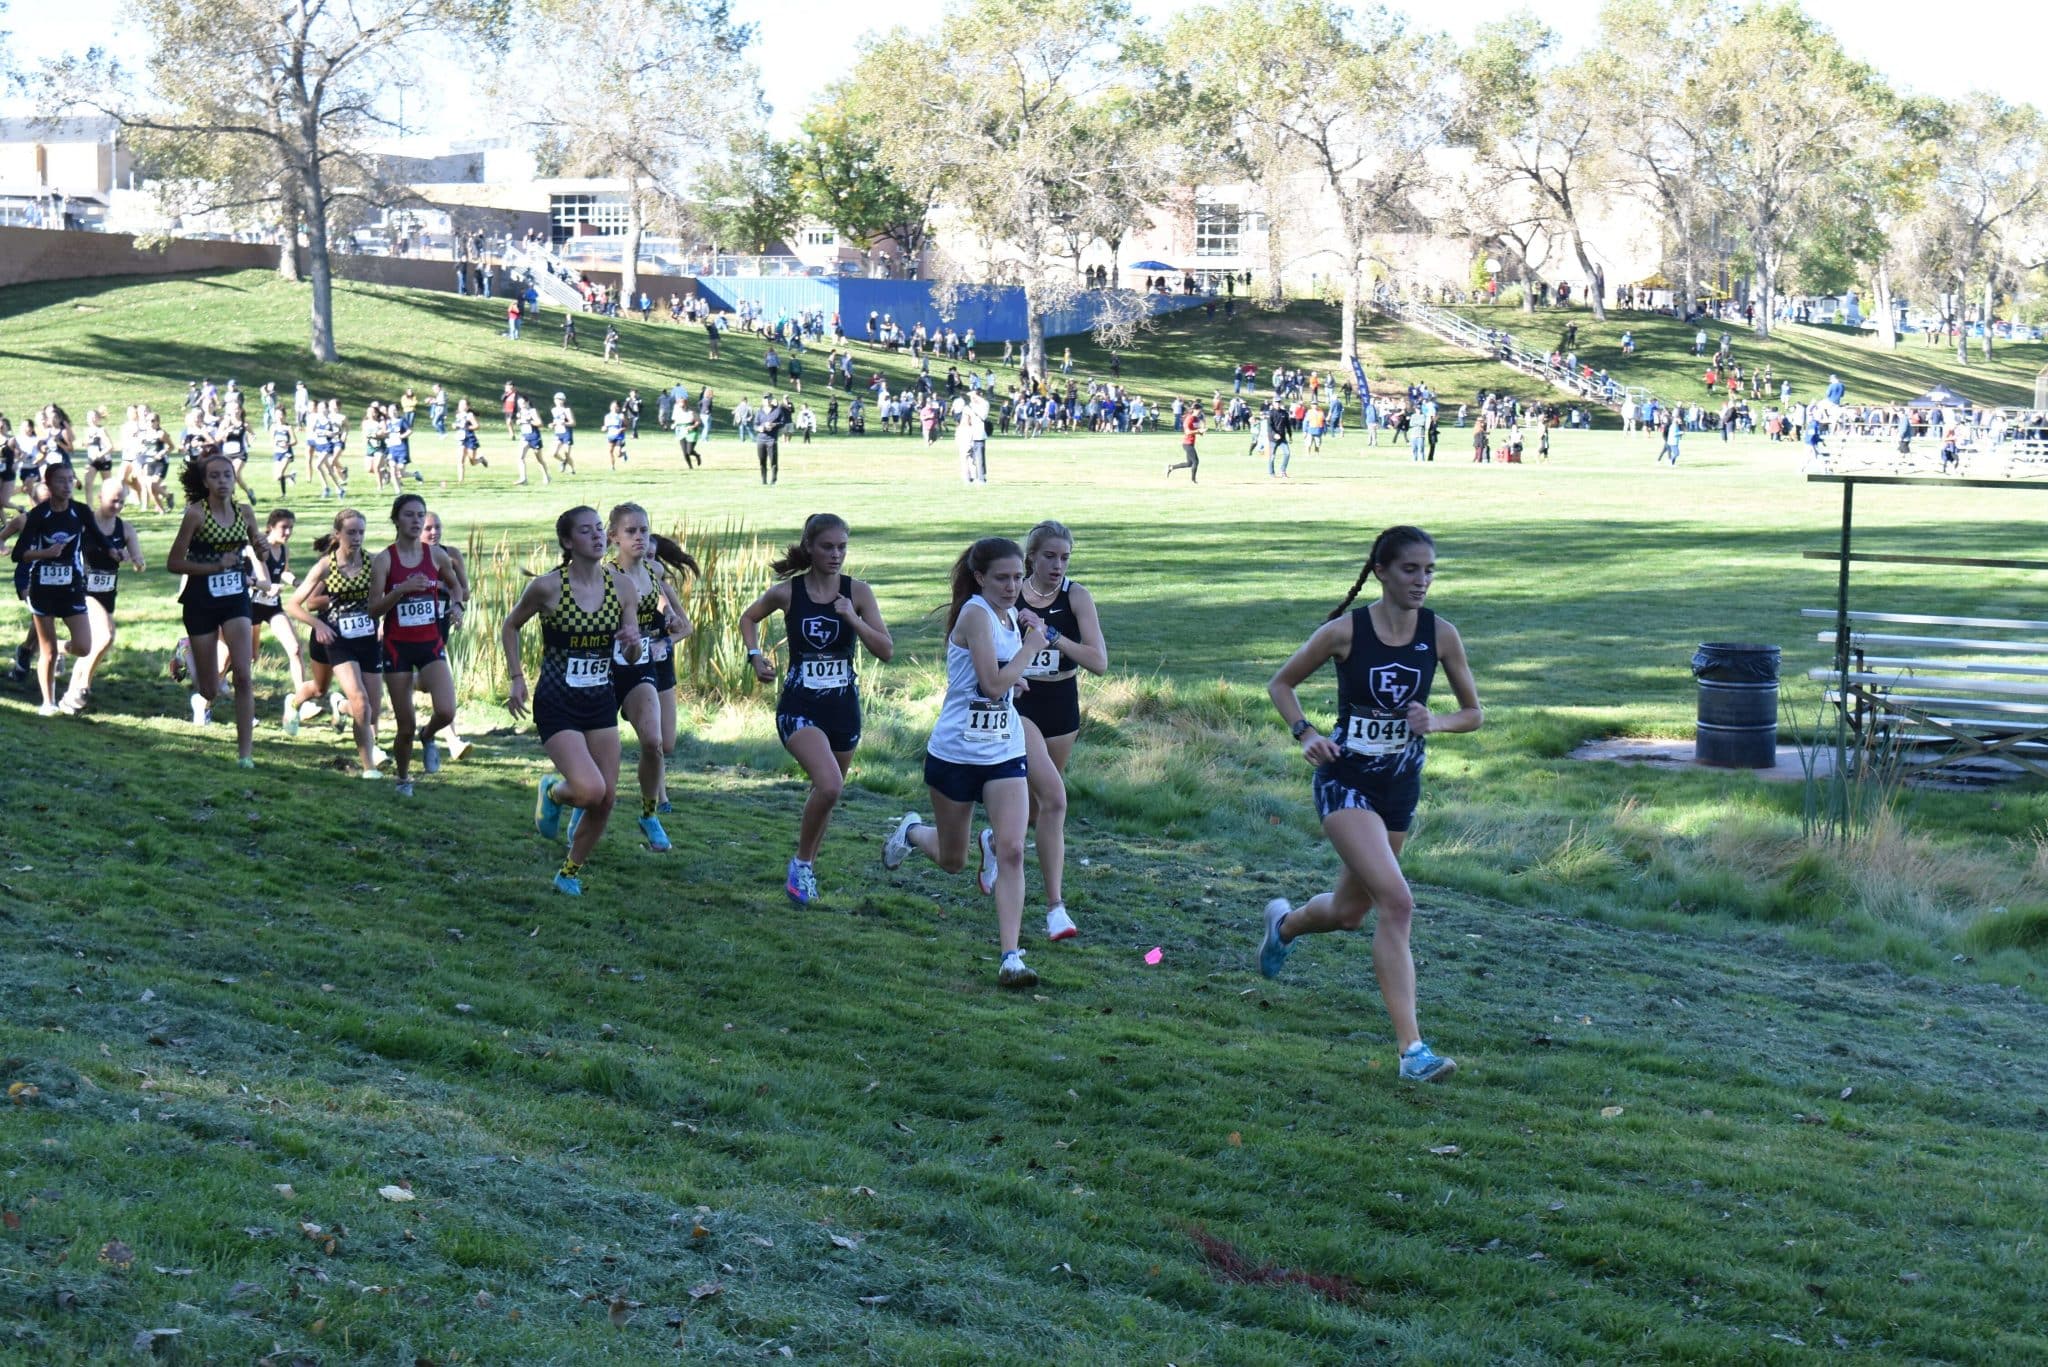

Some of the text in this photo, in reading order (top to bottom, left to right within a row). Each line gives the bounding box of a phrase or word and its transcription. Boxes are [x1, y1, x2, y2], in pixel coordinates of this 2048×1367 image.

[43, 566, 70, 577] 1318
[94, 575, 111, 585] 951
[212, 573, 240, 588] 1154
[401, 602, 433, 617] 1088
[343, 616, 371, 630] 1139
[809, 621, 831, 643] EV
[570, 634, 610, 648] RAMS
[571, 660, 608, 675] 1165
[806, 661, 843, 677] 1071
[1378, 671, 1409, 703] EV
[970, 711, 1008, 729] 1118
[1353, 719, 1407, 740] 1044
